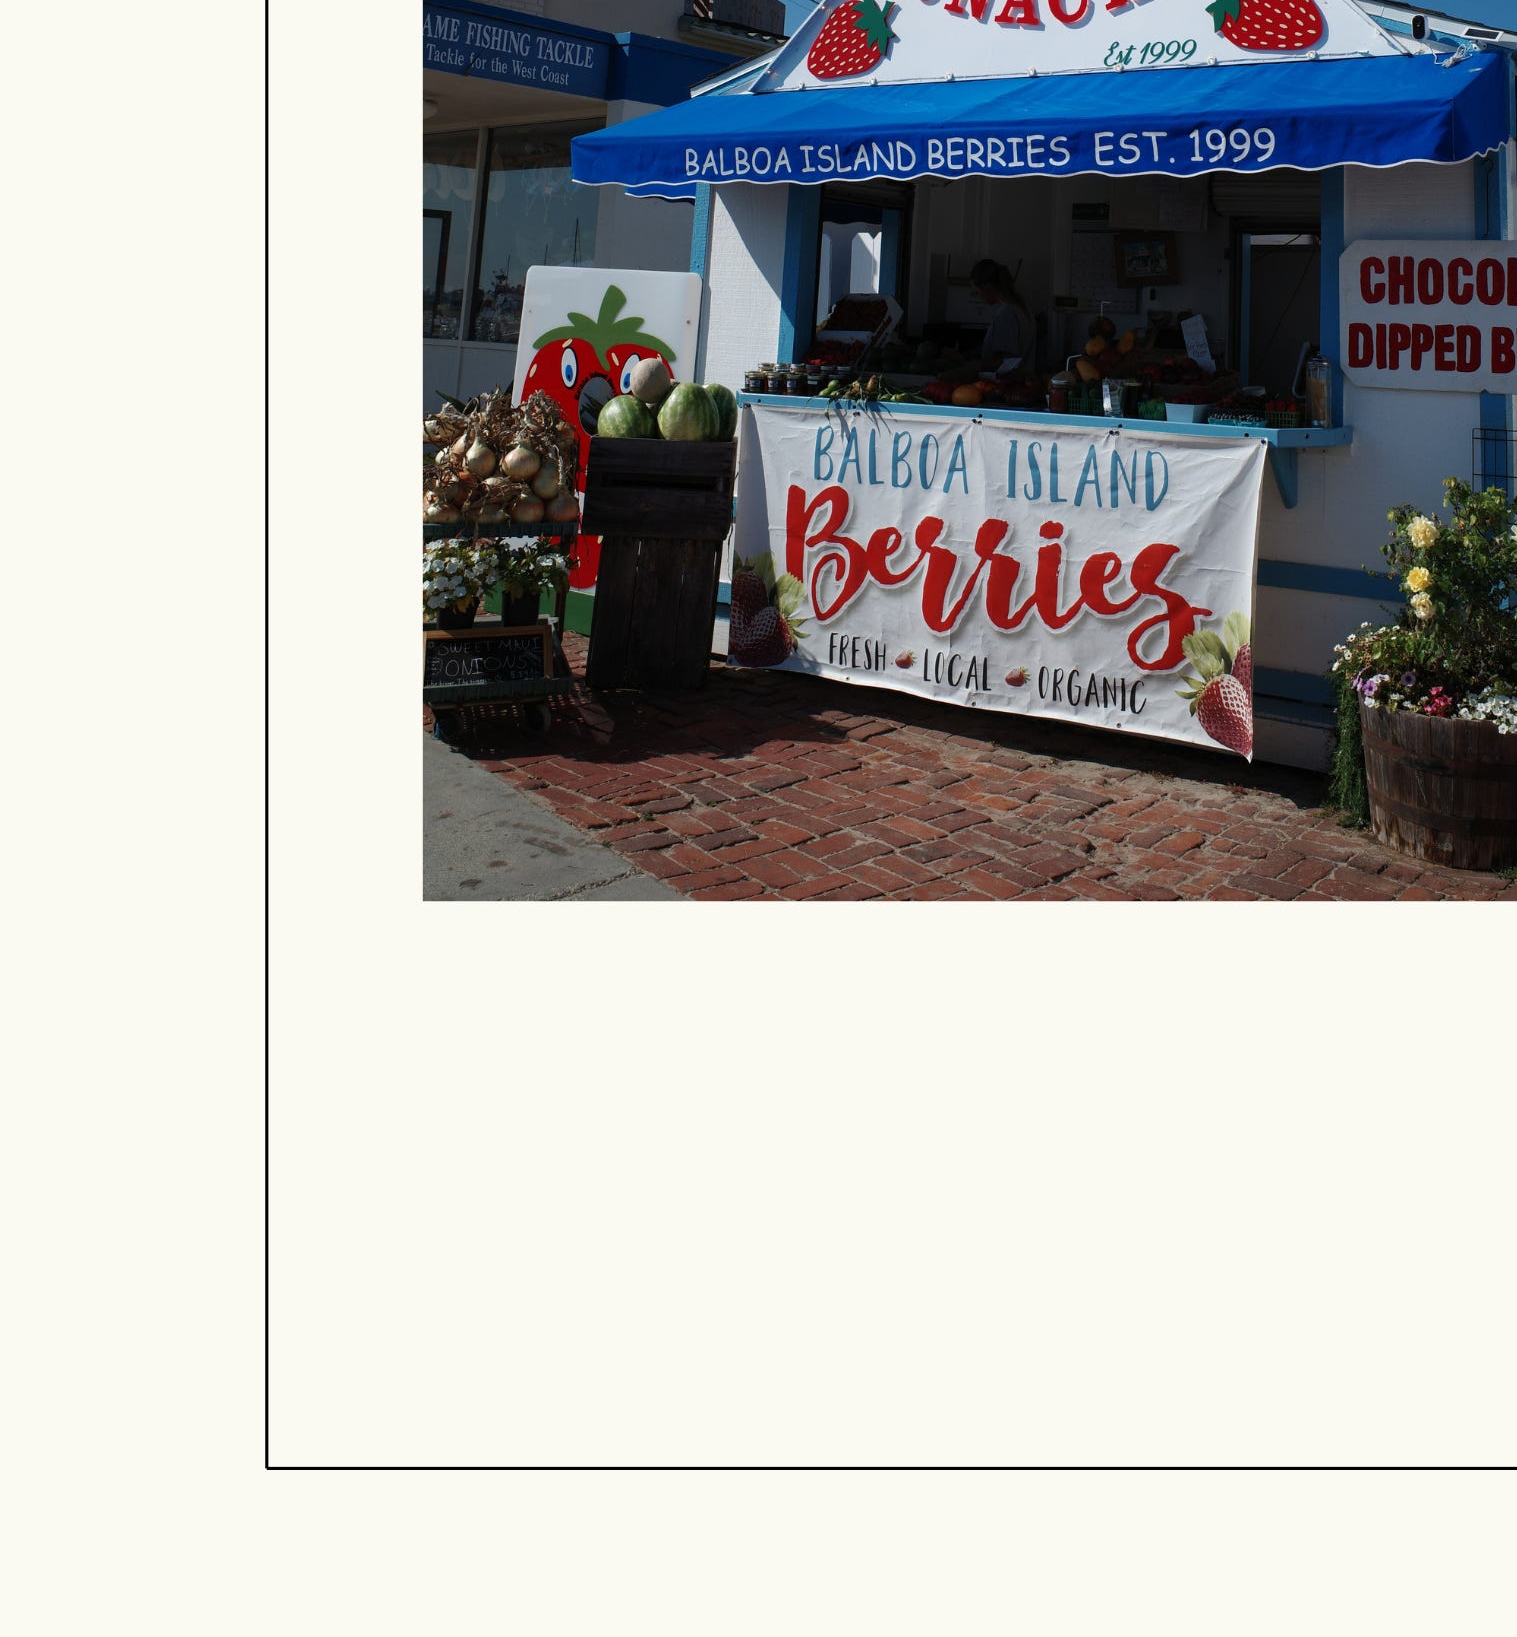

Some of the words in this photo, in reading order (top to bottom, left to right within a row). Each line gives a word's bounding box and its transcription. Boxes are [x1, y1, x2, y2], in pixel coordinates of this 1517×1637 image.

[426, 43, 465, 66] Tackle
[469, 52, 487, 69] for
[491, 57, 508, 75] the
[512, 59, 537, 81] West
[540, 65, 571, 85] Coast
[465, 21, 531, 57] FISHING
[536, 36, 594, 69] TACKLE
[1103, 42, 1135, 68] Est
[1140, 39, 1197, 65] 1999
[684, 143, 792, 177] BALBOA
[799, 138, 917, 174] ISLAND
[927, 134, 1070, 171] BERRIES
[1094, 131, 1177, 166] EST.
[1190, 127, 1276, 163] 1999
[1347, 323, 1482, 375] DIPPED
[813, 424, 969, 495] BALBOA
[1007, 439, 1170, 512] ISLAND
[785, 484, 1213, 671] Berries
[437, 641, 491, 656] SWEET
[498, 637, 541, 650] MAUI
[445, 655, 529, 677] ONIONS
[829, 633, 887, 672] FRESH
[923, 650, 992, 692] LOCAL
[1038, 666, 1147, 715] ORGANIC
